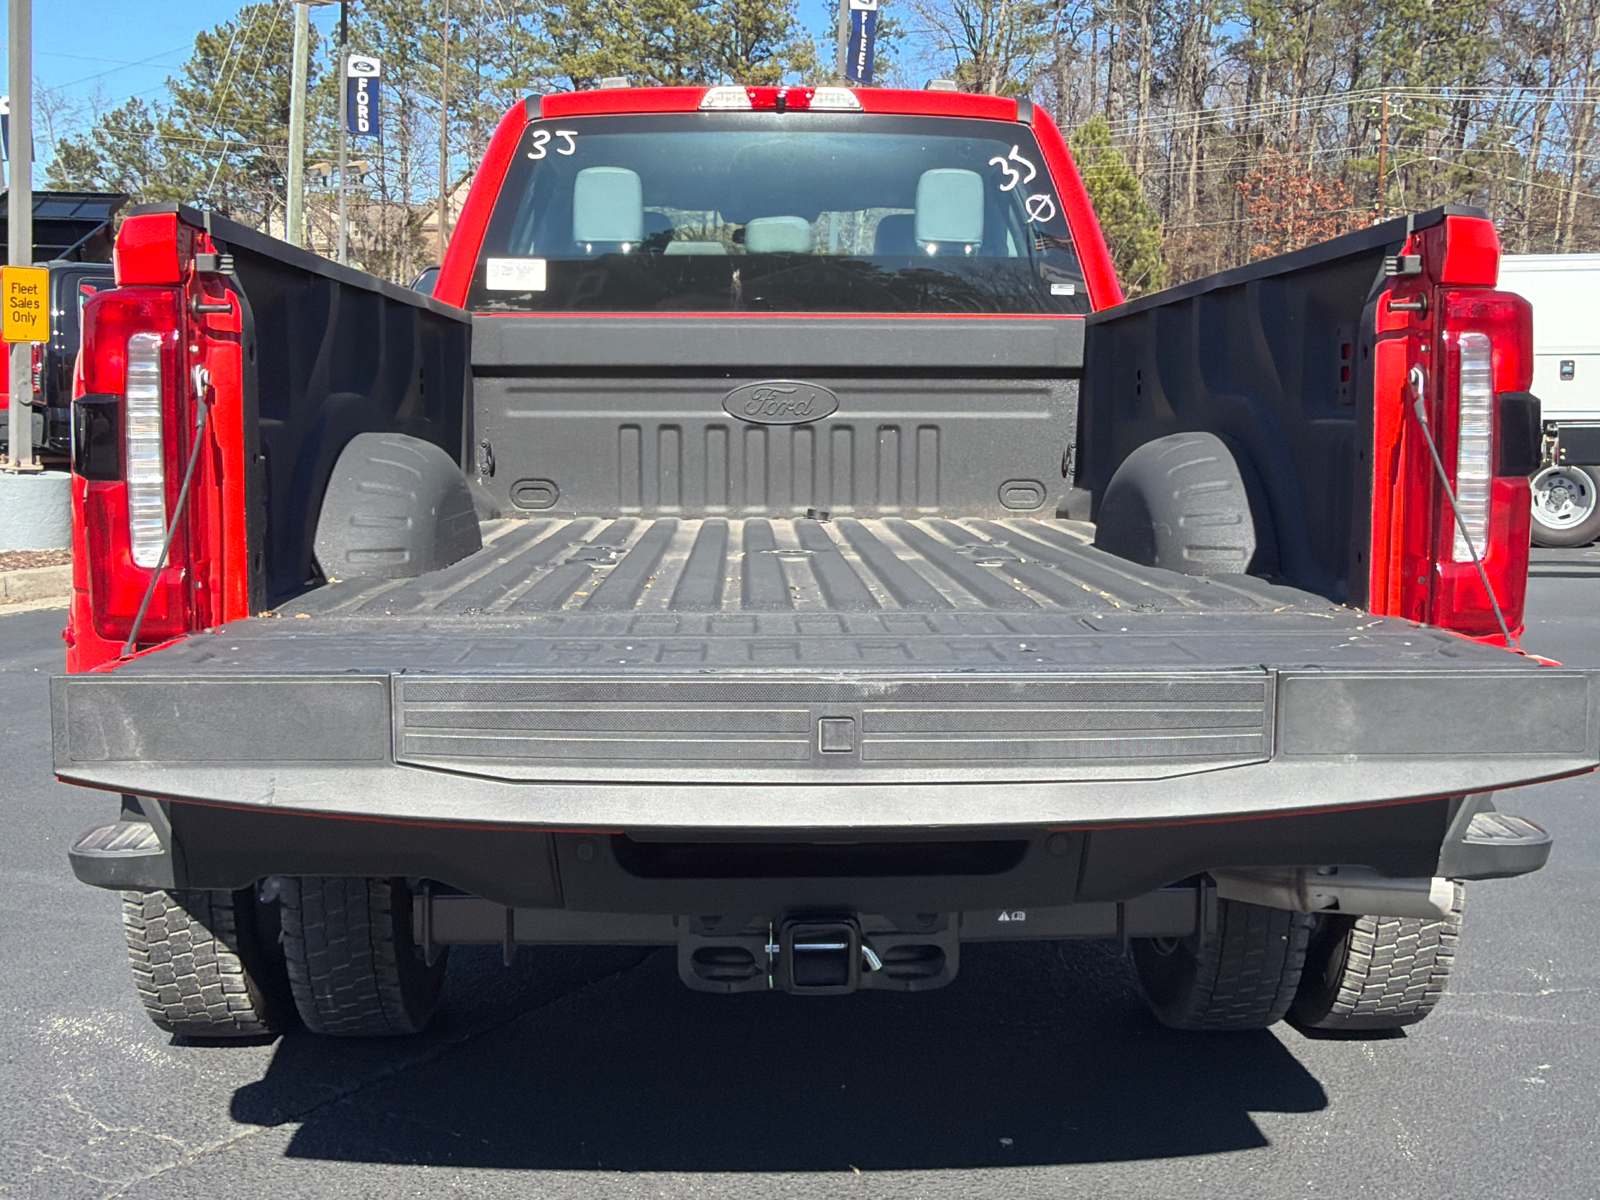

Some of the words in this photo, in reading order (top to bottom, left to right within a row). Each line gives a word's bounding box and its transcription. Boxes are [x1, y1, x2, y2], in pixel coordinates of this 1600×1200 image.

[857, 11, 867, 78] FLEET
[356, 77, 369, 132] FORD
[11, 282, 38, 295] Fleet
[10, 296, 40, 309] Sales
[12, 310, 37, 326] Only
[744, 386, 816, 416] Ford
